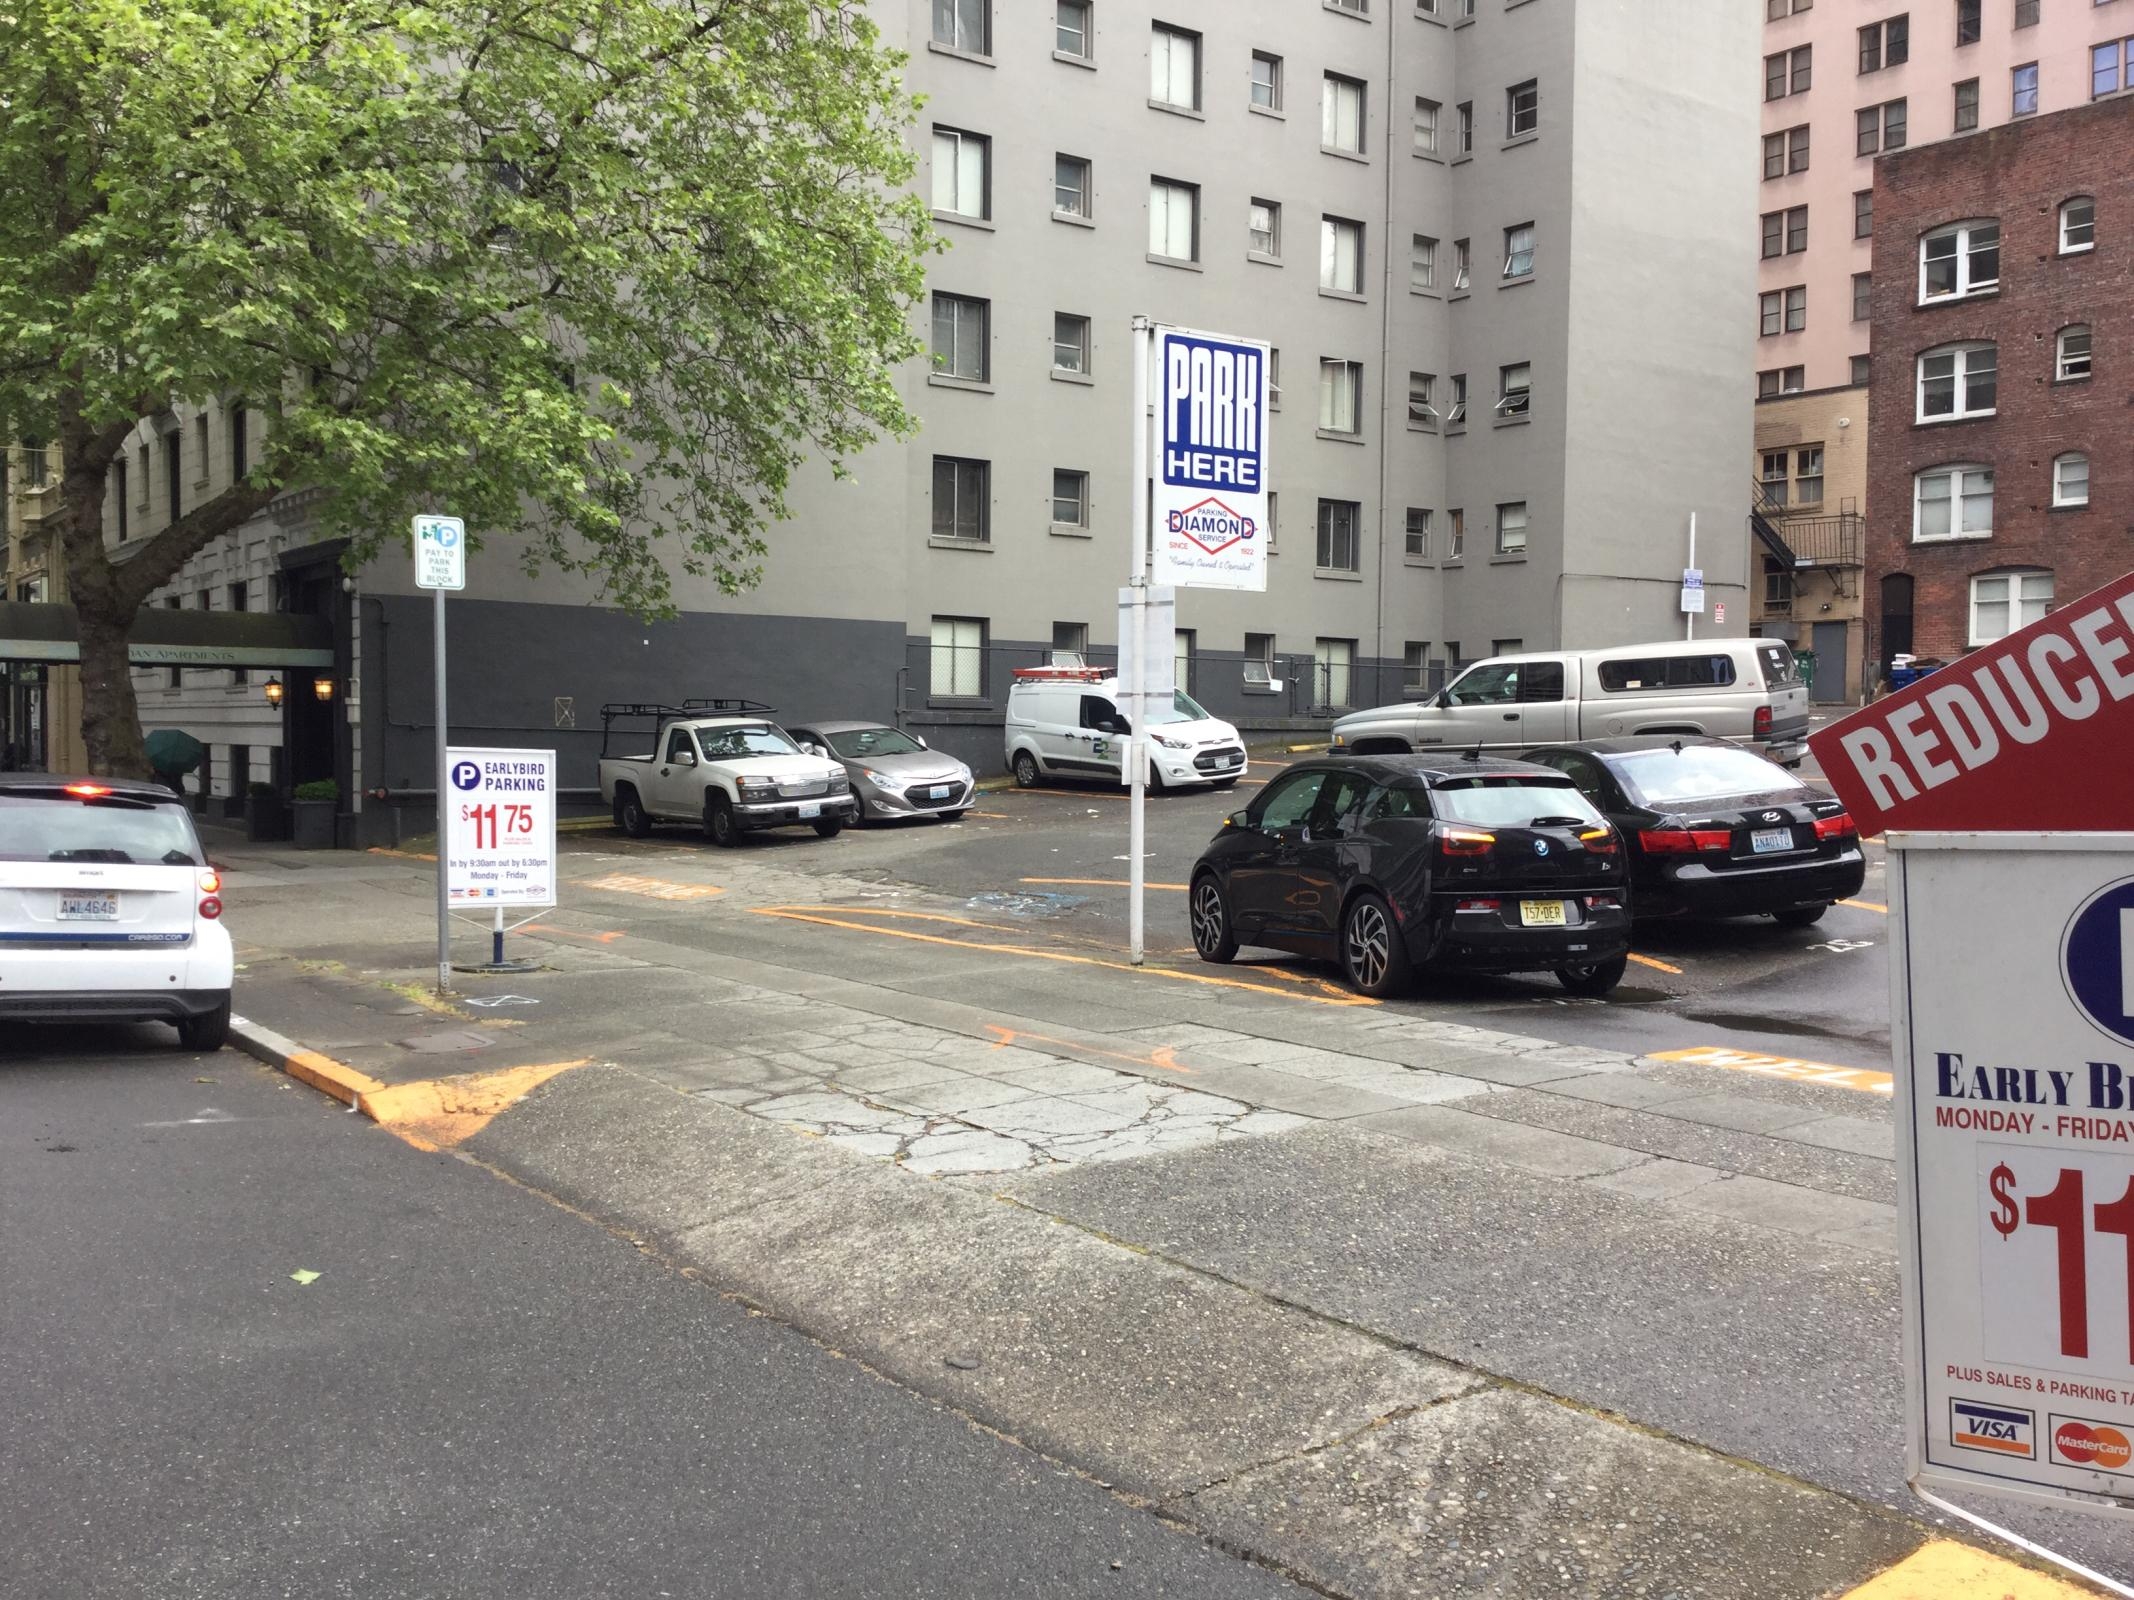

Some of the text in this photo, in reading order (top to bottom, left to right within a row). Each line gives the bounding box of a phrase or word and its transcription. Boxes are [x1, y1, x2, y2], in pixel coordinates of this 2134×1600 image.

[1167, 342, 1257, 452] PARK
[1168, 449, 1257, 486] HERE
[1197, 508, 1228, 518] PARKING
[1168, 509, 1255, 540] DIAMOND
[1198, 533, 1227, 542] SERVICE
[425, 549, 440, 557] PAY
[428, 558, 450, 566] PARK
[431, 566, 449, 575] THIS
[426, 575, 454, 584] BLOCK
[155, 650, 235, 660] APARTMENTS
[1840, 591, 2134, 812] REDUCE
[485, 762, 545, 775] EARLYBIRD
[485, 778, 545, 791] PARKING
[459, 859, 468, 869] by
[470, 859, 496, 867] 9:30am
[498, 859, 510, 867] out
[512, 858, 520, 868] by
[470, 871, 499, 880] Monday
[506, 870, 528, 880] Friday
[1934, 1052, 2074, 1107] EARLY
[1936, 1106, 2035, 1135] MONDAY
[2057, 1115, 2134, 1143] FRIDA
[1947, 1365, 1983, 1383] PLUS
[1986, 1371, 2032, 1391] SALES
[2036, 1378, 2046, 1393] &
[2050, 1380, 2117, 1404] PARKING
[1968, 1417, 2018, 1441] VISA
[2057, 1434, 2129, 1457] MasterCard
